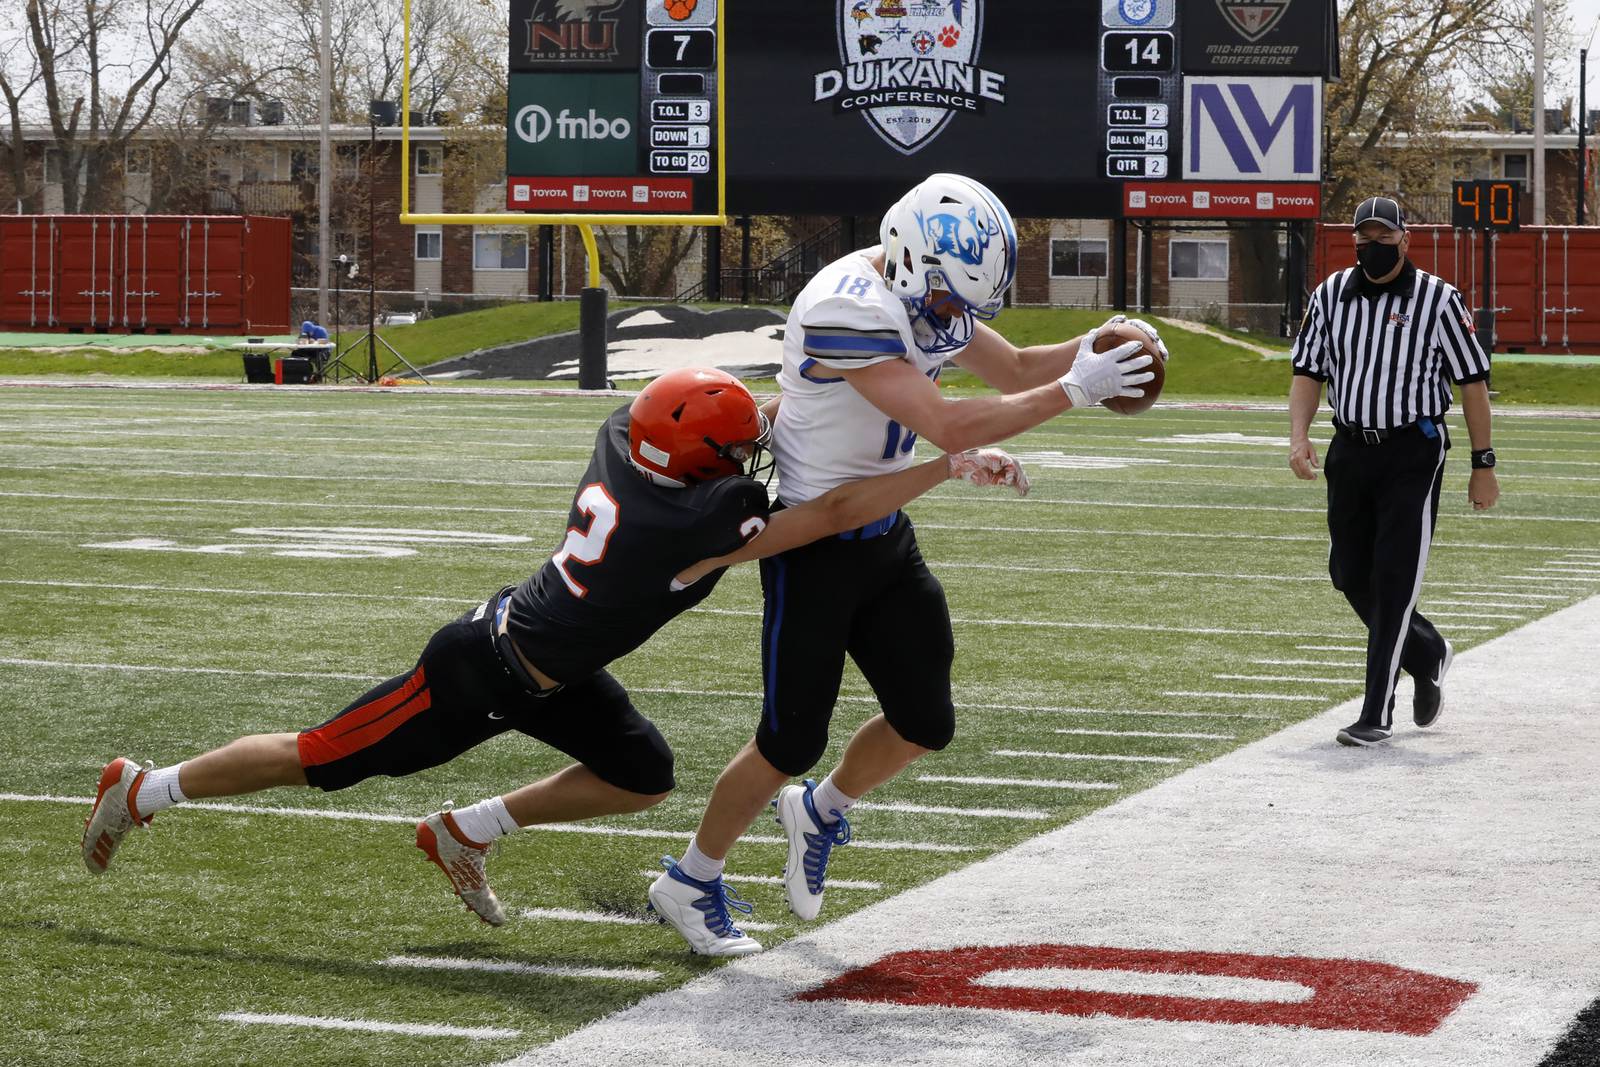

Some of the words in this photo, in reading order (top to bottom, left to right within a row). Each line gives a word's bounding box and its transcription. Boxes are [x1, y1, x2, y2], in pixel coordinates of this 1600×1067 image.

[531, 22, 612, 50] NIU
[673, 35, 691, 61] 7
[1124, 38, 1161, 65] 14
[1211, 56, 1294, 65] CONFERENCE
[814, 58, 1006, 103] DUKANE
[841, 91, 977, 110] CONFERENCE
[658, 106, 685, 117] T.O.L.
[694, 104, 703, 117] 3
[1114, 110, 1142, 120] T.O.L.
[1152, 108, 1160, 121] 2
[556, 108, 631, 140] fnbo
[655, 131, 687, 142] DOWN
[693, 131, 700, 143] 1
[1110, 135, 1131, 145] BALL
[1132, 135, 1145, 145] ON
[1147, 135, 1164, 148] 44
[655, 156, 669, 167] TO
[671, 156, 686, 167] GO
[691, 154, 708, 167] 20
[1116, 160, 1138, 171] QTR
[1151, 160, 1160, 173] 2
[532, 189, 568, 198] TOYOTA
[591, 189, 627, 198] TOYOTA
[651, 190, 687, 199] TOYOTA
[1149, 195, 1187, 204] TOYOTA
[1212, 195, 1250, 204] TOYOTA
[1276, 196, 1314, 206] TOYOTA
[1457, 184, 1513, 225] 40
[833, 274, 873, 298] 18
[881, 418, 917, 460] 1
[552, 481, 620, 599] 2
